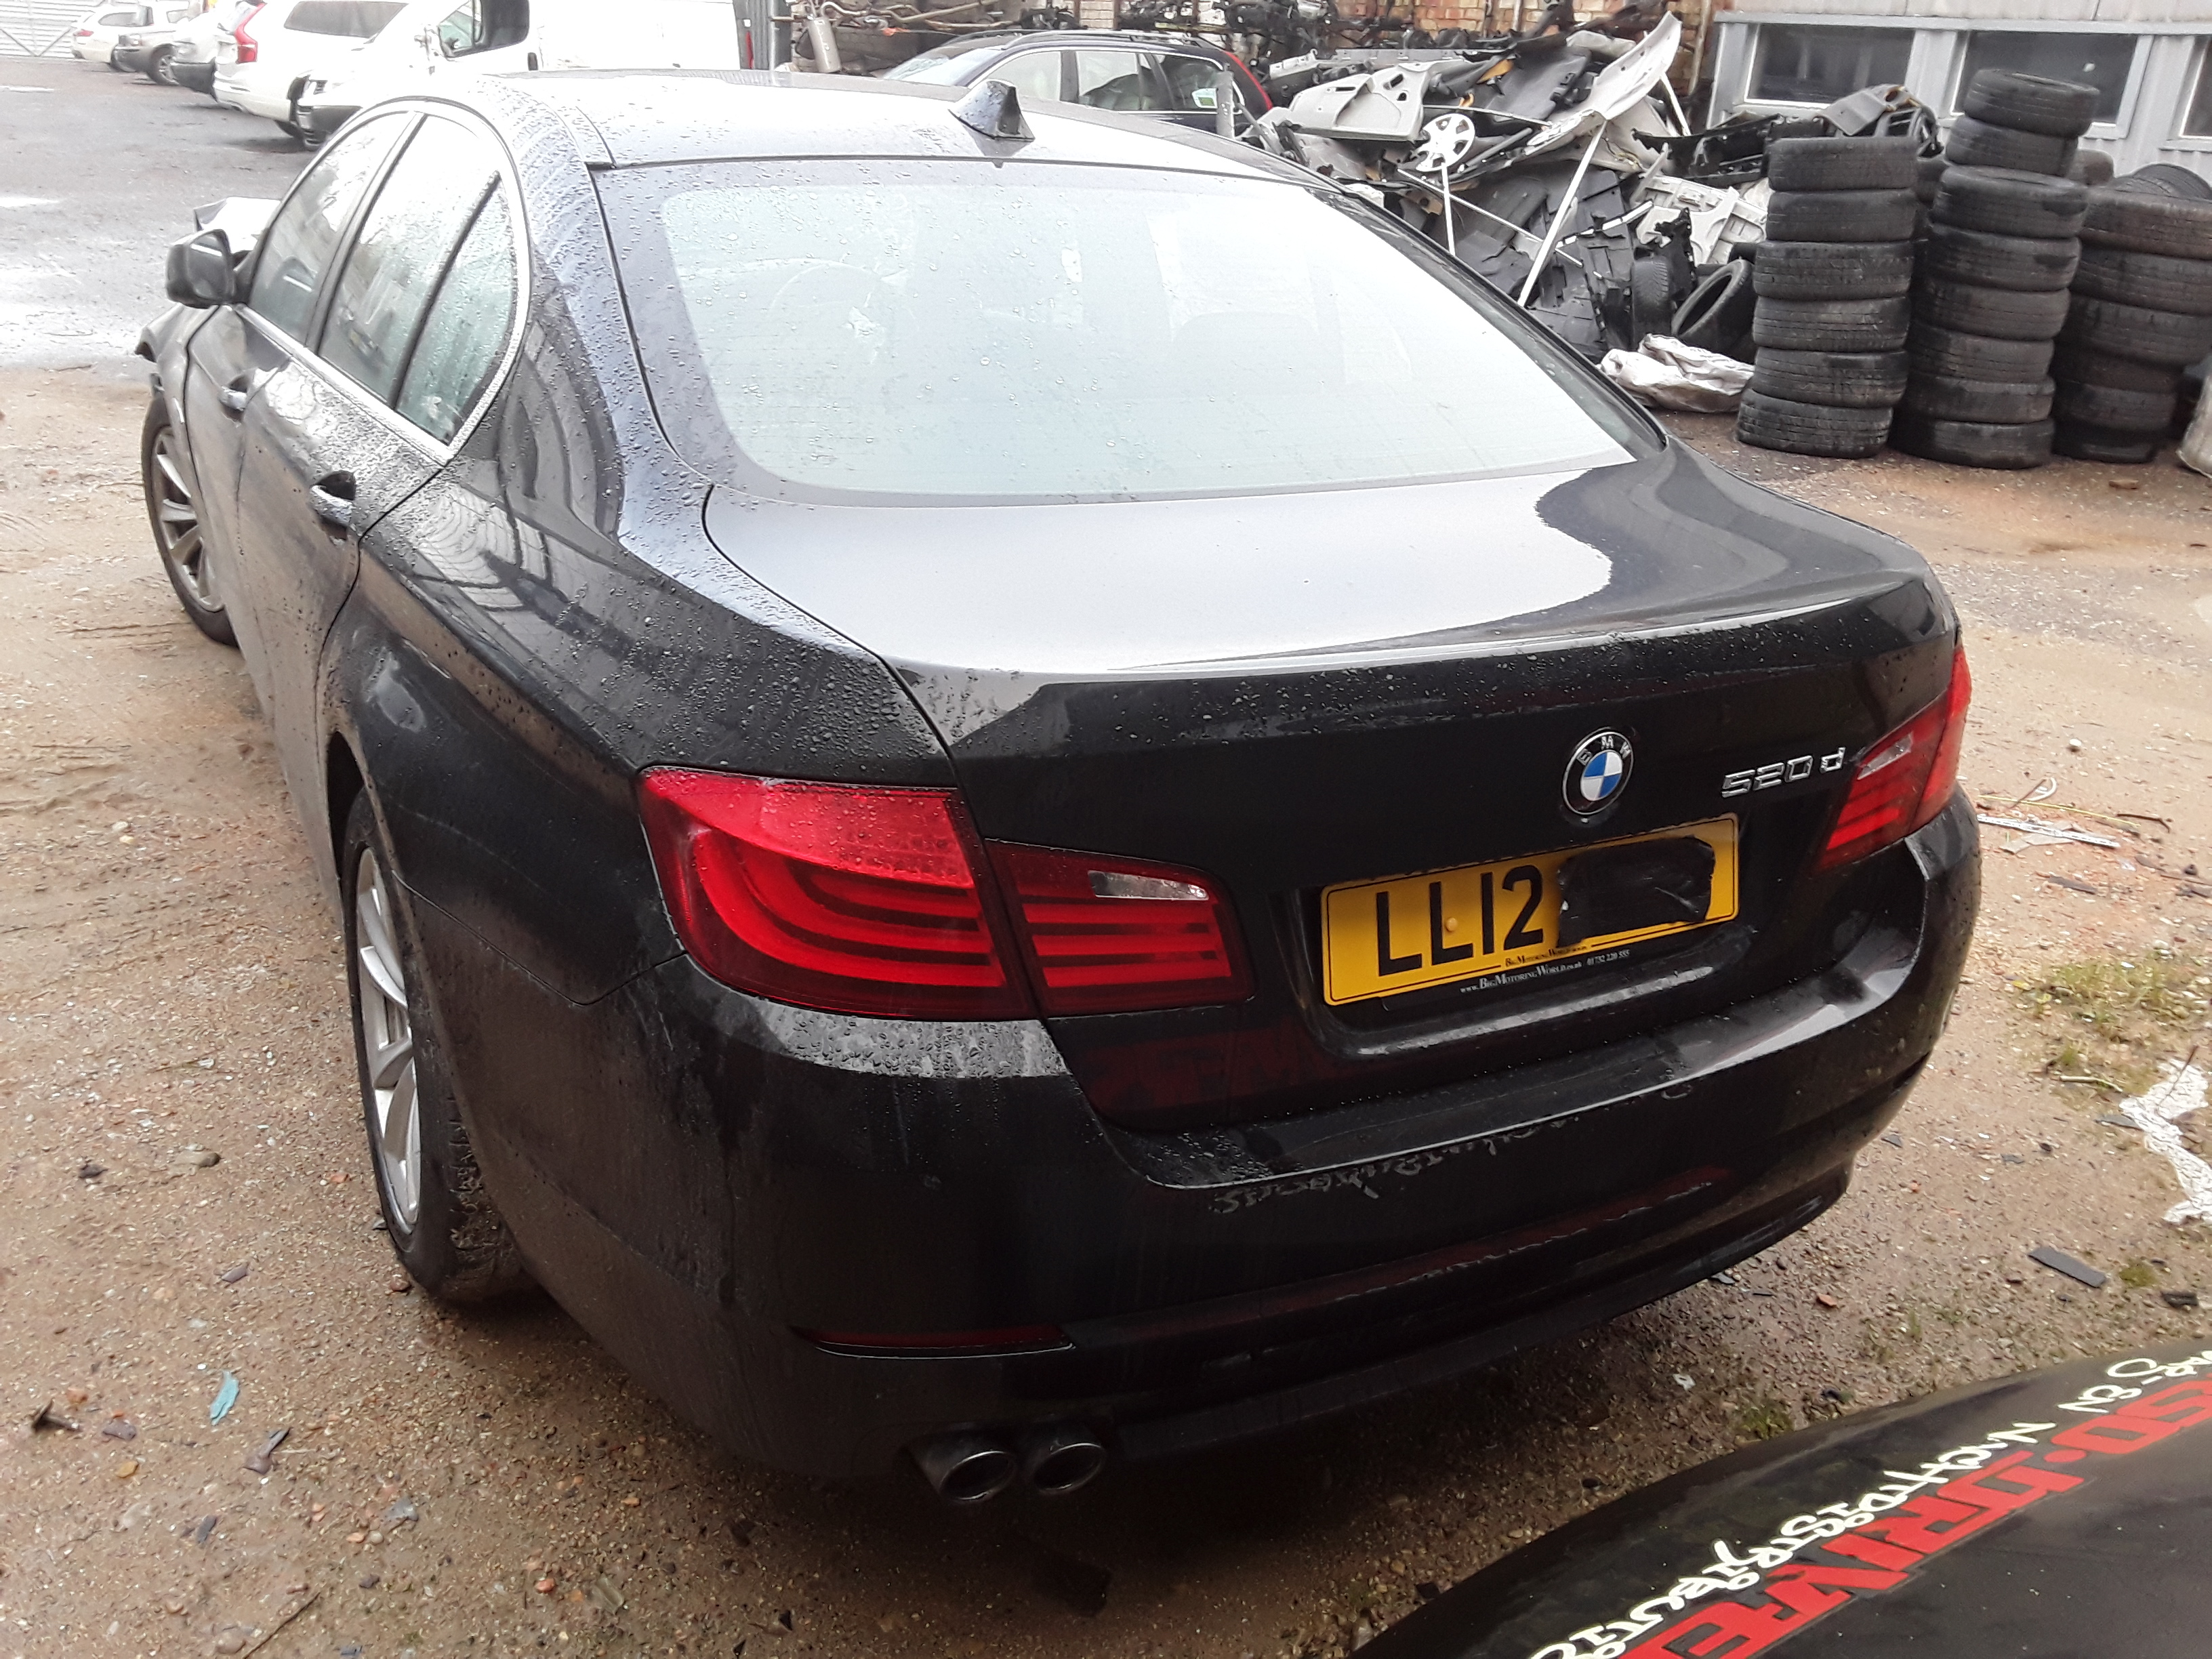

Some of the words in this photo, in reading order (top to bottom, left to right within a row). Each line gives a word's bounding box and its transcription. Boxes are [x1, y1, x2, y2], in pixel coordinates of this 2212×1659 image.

[1576, 735, 1631, 766] BMW
[1720, 754, 1814, 798] 520
[1820, 746, 1846, 774] d
[1376, 864, 1544, 977] LL12
